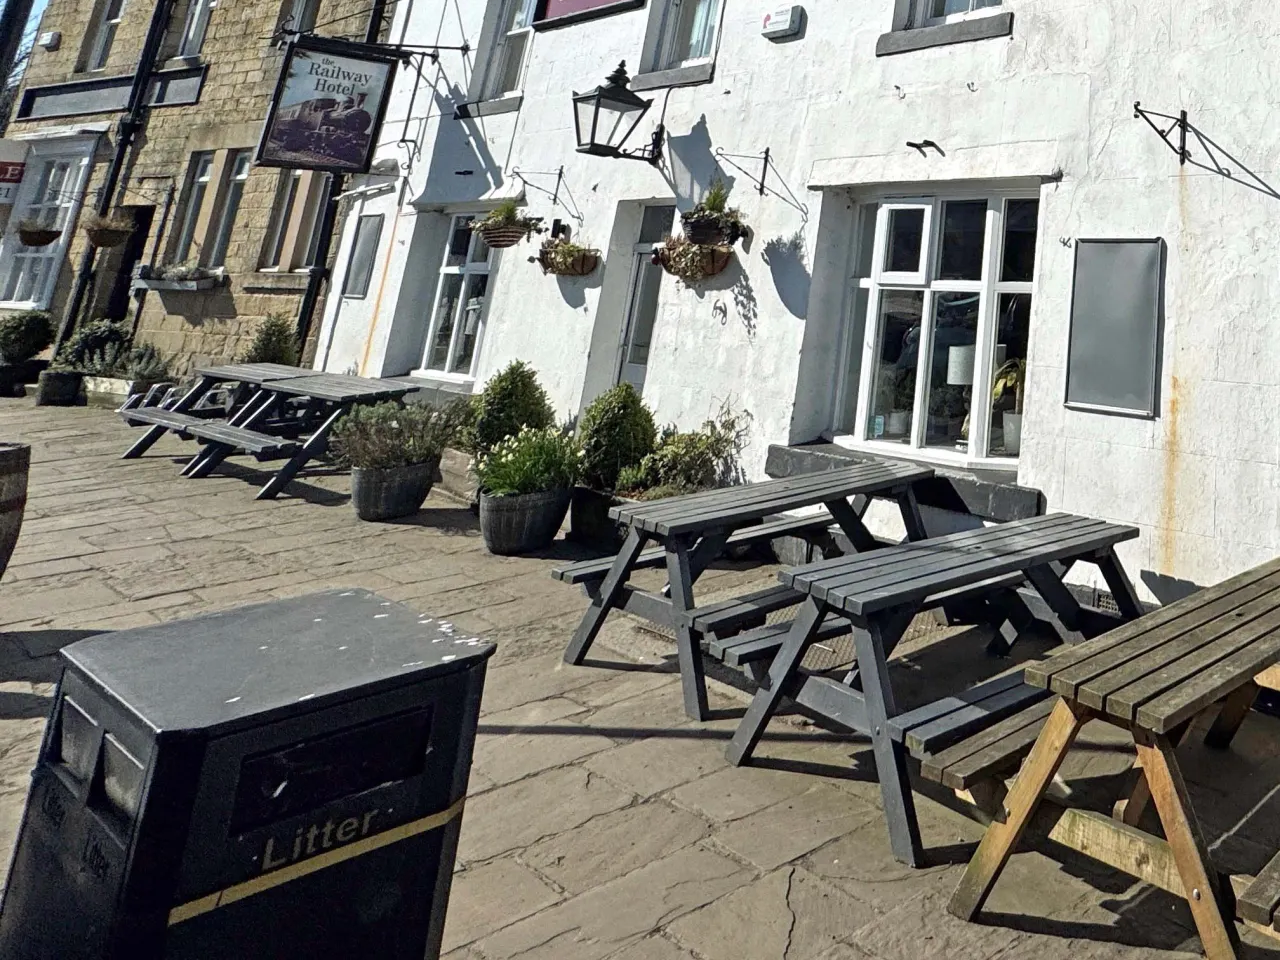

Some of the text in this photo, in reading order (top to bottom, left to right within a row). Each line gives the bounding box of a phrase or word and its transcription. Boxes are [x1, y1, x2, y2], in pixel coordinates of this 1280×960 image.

[321, 57, 334, 66] the
[308, 62, 372, 86] Railway
[313, 78, 355, 96] Hotel
[262, 809, 379, 871] Litter
